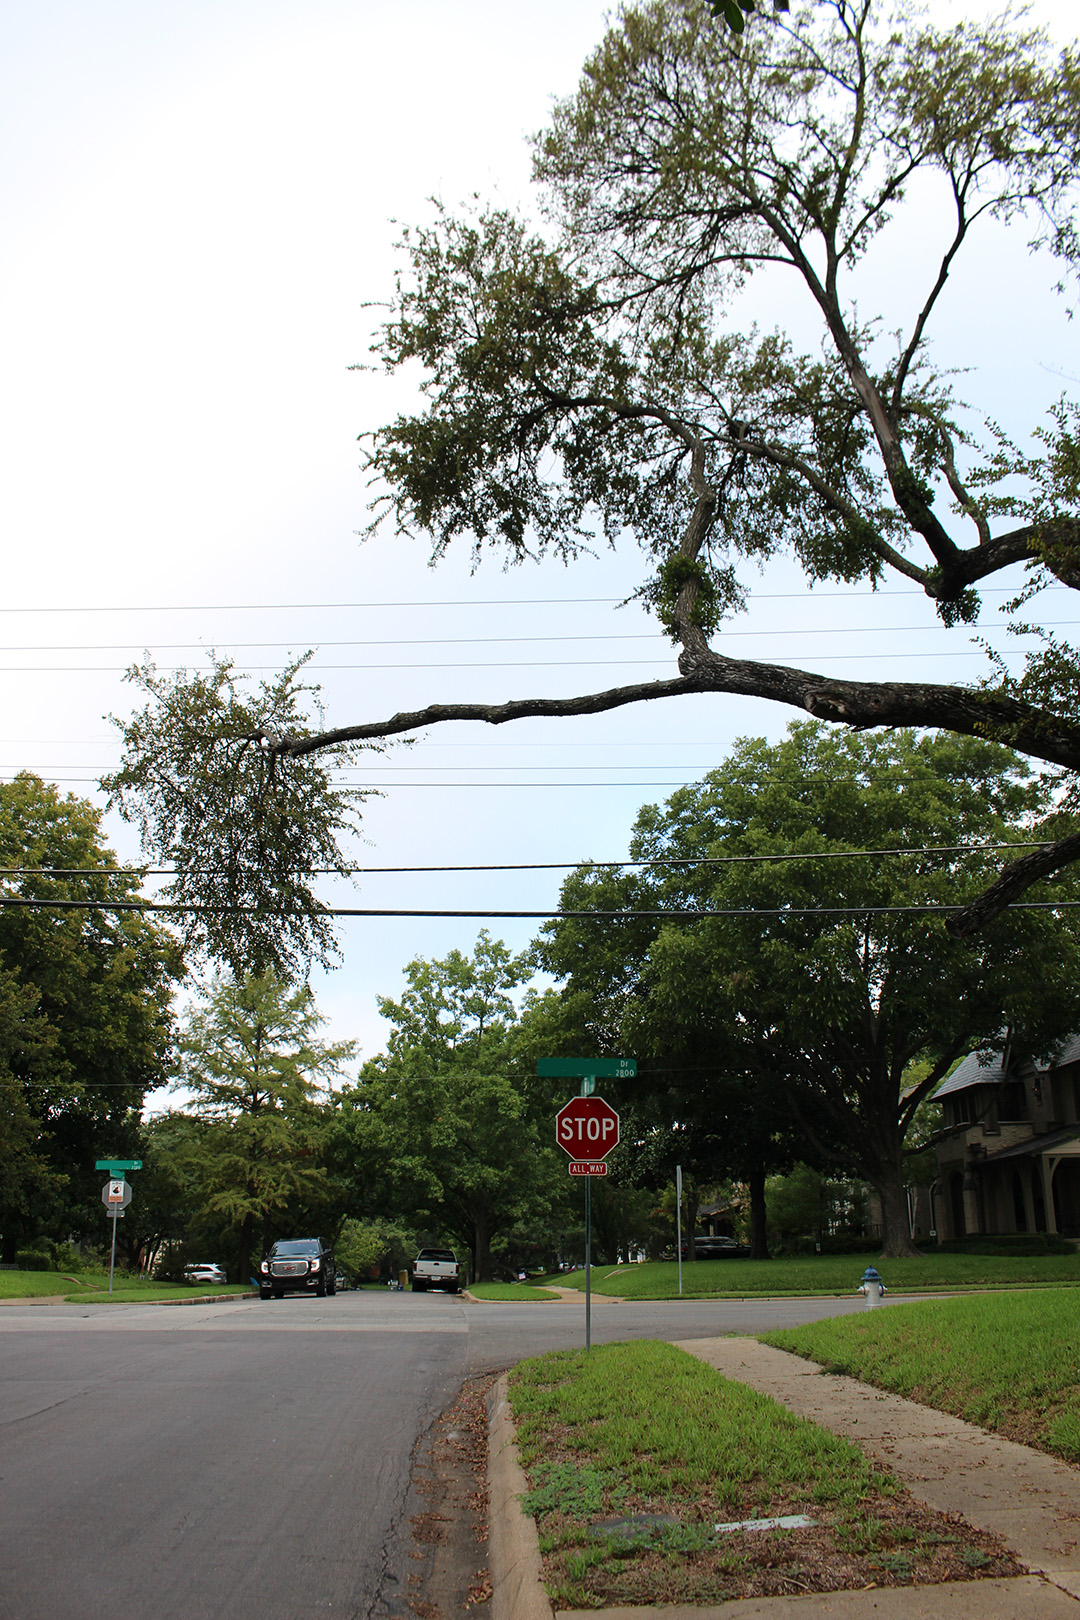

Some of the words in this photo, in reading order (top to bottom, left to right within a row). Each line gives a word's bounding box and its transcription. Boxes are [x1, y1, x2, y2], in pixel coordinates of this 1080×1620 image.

[615, 1069, 635, 1077] 2800
[561, 1117, 615, 1140] STOP
[572, 1164, 585, 1173] ALL
[589, 1164, 604, 1173] WAY
